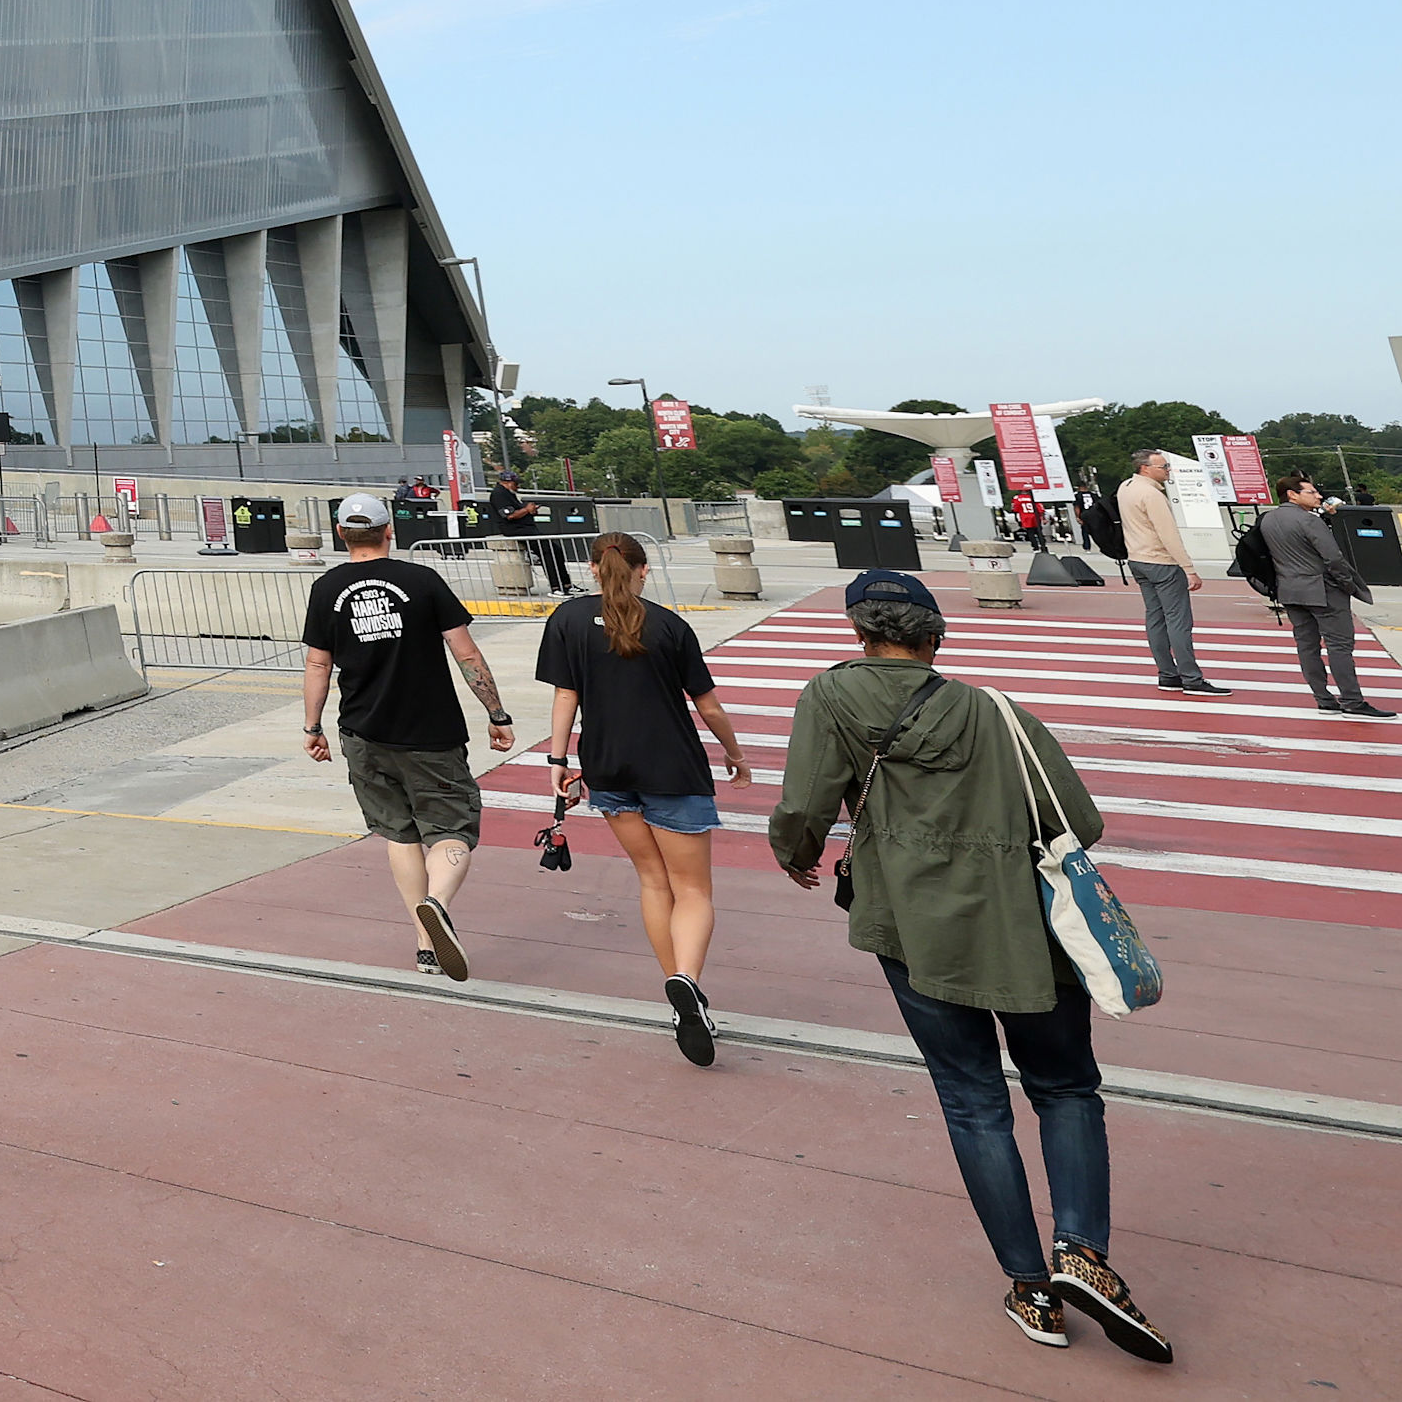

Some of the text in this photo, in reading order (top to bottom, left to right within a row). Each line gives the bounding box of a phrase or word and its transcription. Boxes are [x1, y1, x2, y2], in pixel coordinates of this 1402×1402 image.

[443, 441, 454, 480] Information
[1021, 503, 1034, 513] 19
[360, 589, 379, 599] 1903
[350, 597, 395, 618] HARLEY-
[350, 612, 403, 634] DAVIDSON
